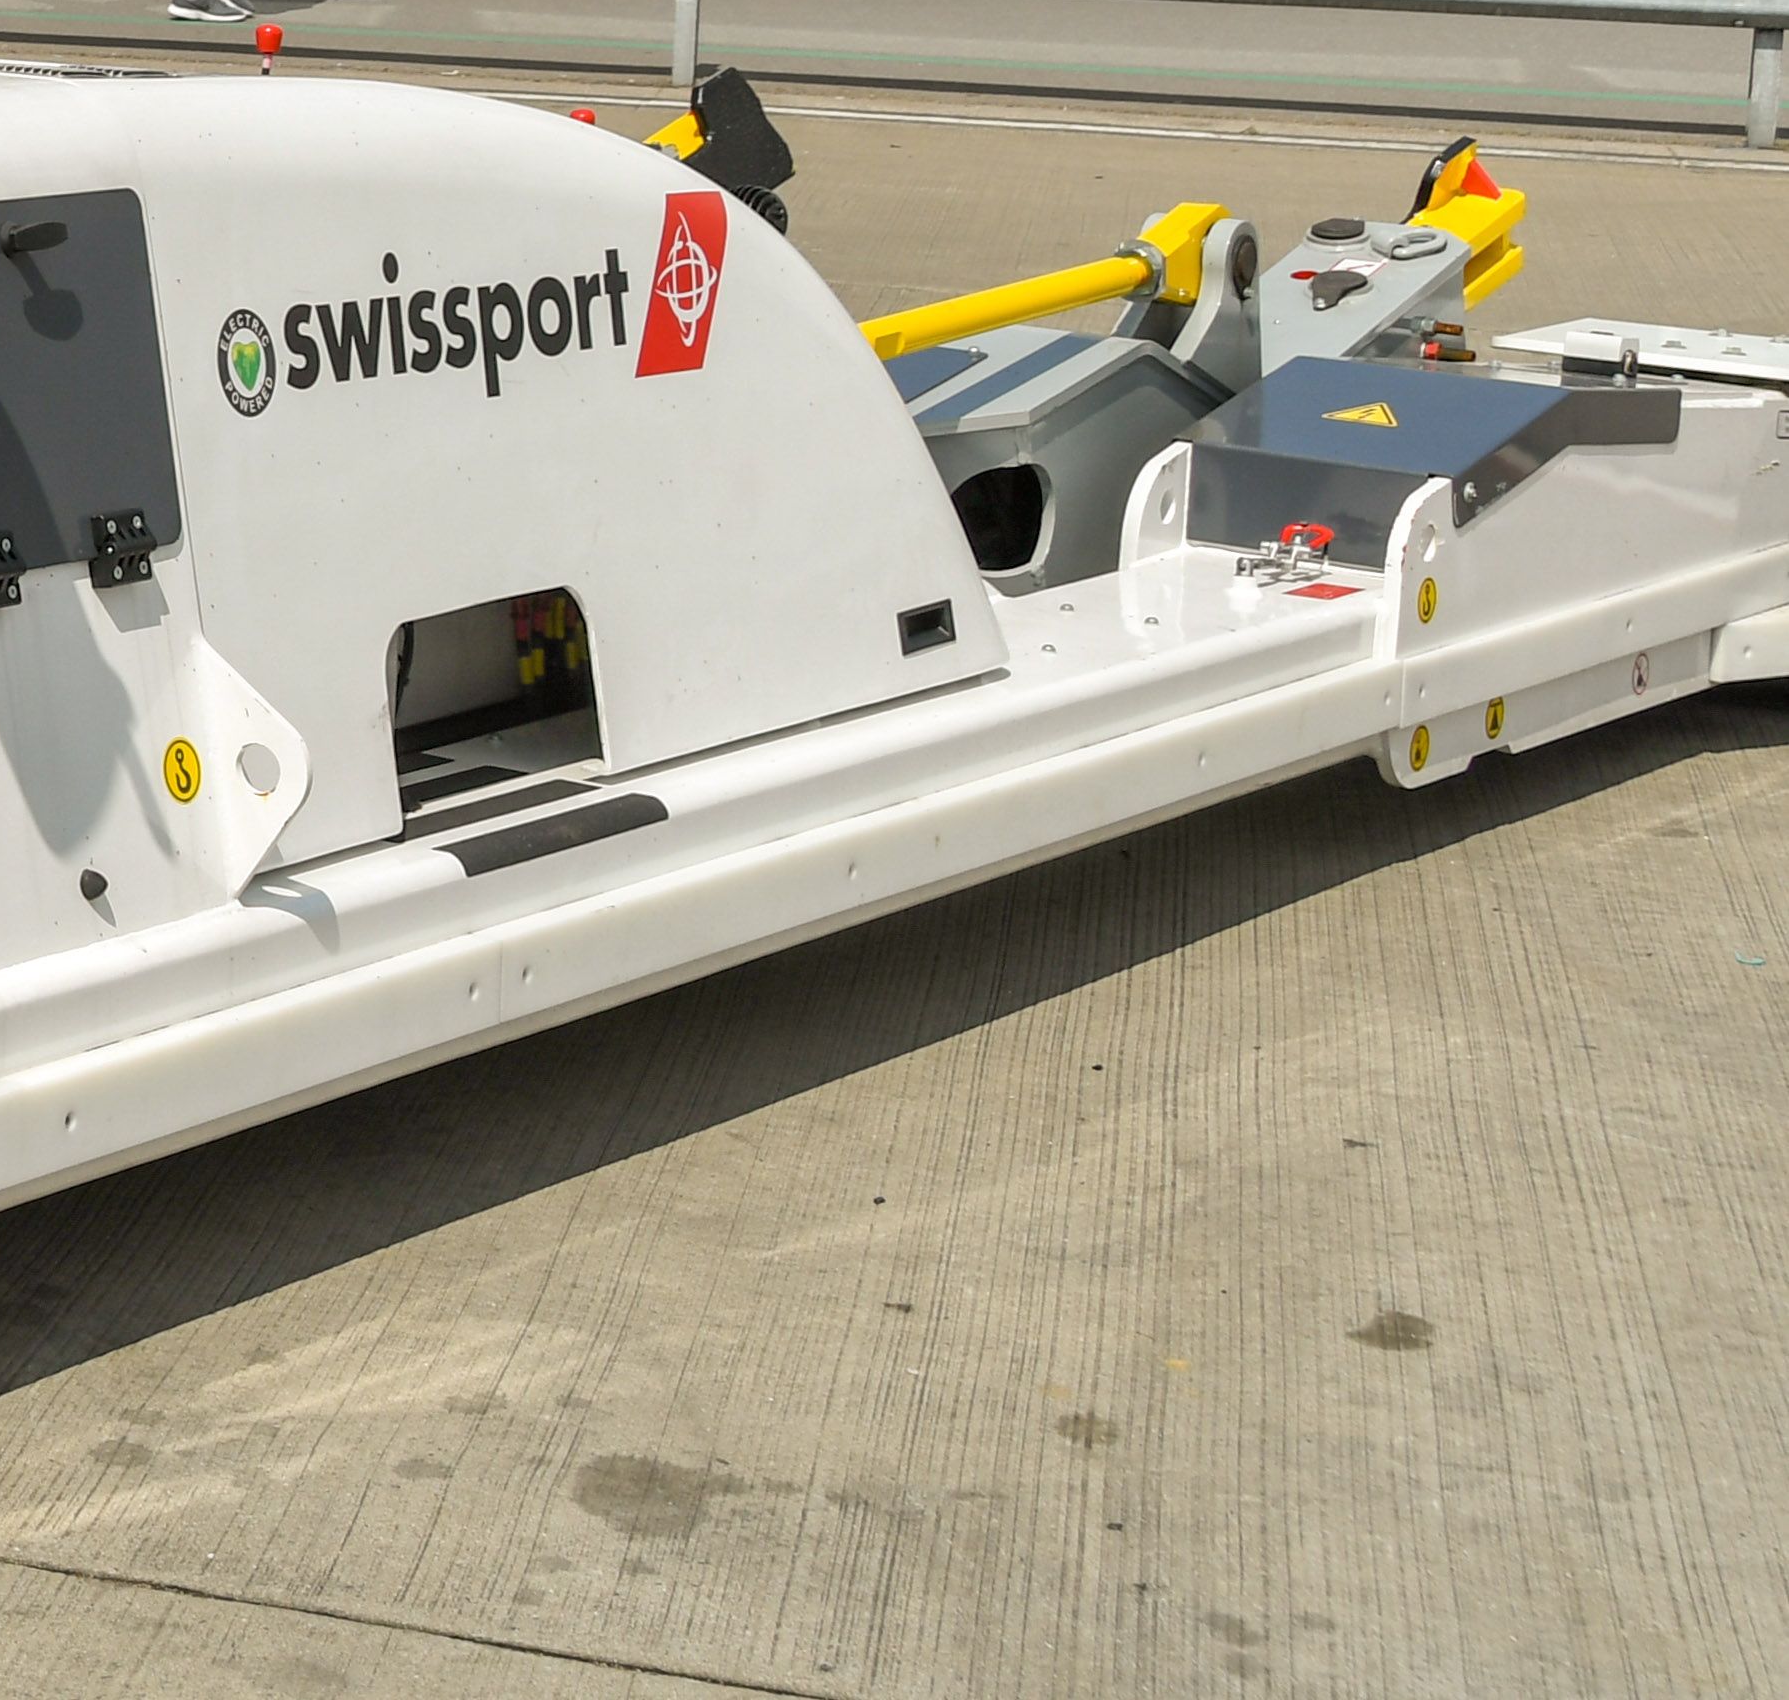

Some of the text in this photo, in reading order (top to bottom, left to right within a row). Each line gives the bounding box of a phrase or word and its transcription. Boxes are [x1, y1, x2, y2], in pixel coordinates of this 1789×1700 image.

[220, 313, 270, 352] ELECTRIC
[284, 250, 629, 398] swissport
[225, 376, 273, 413] POWERED
